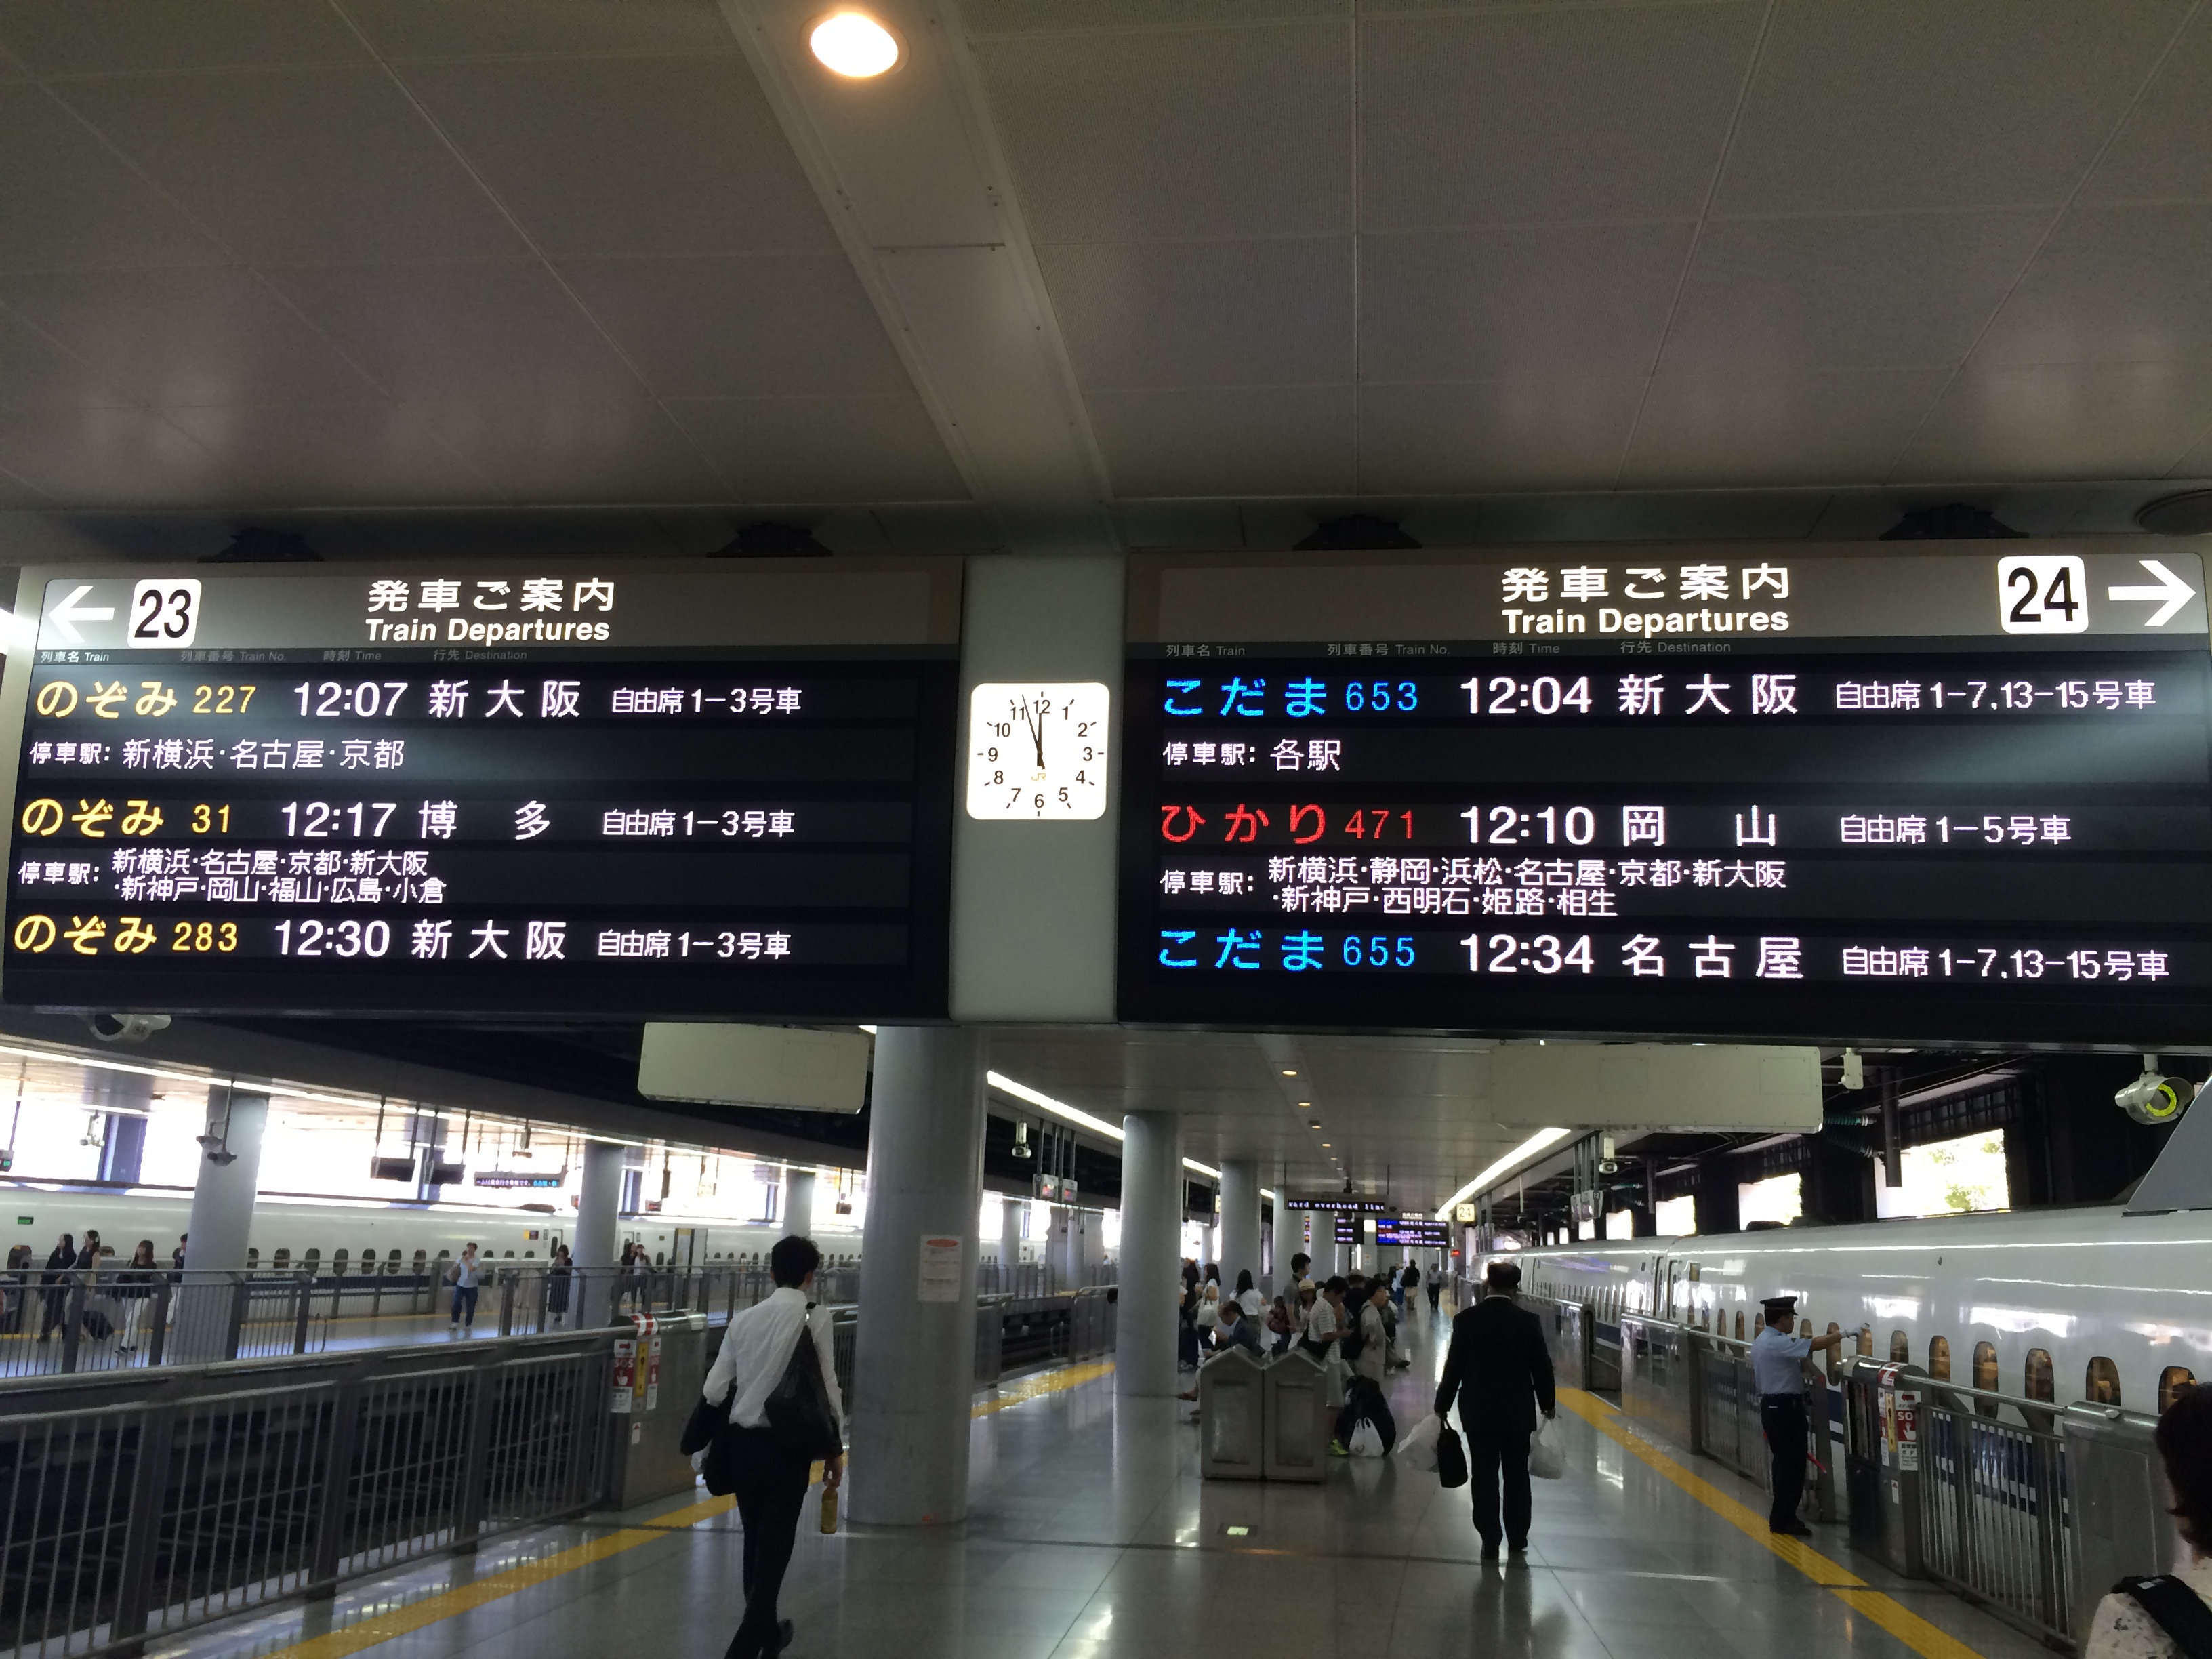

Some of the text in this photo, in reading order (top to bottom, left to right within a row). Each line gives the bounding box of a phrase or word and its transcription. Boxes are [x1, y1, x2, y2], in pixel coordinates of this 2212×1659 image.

[1502, 563, 1789, 602] 発車ご案内
[367, 577, 615, 613] 発車ご案内
[2007, 567, 2078, 622] 24
[134, 589, 192, 638] 23
[1502, 609, 1789, 638] Train Departures
[365, 618, 610, 646] Train Departures
[1166, 644, 1245, 657] 列車名 Train
[1328, 642, 1450, 656] 列車番号 Train No.
[1493, 642, 1559, 654] 時刻 Time
[1620, 641, 1731, 653] 行先 Destination
[41, 651, 109, 663] 列車名 Train
[181, 651, 286, 661] 列車番号 Train No.
[323, 650, 381, 661] 時刻 Time
[433, 649, 527, 660] 行先 Destination
[36, 680, 178, 718] のぞみ
[193, 685, 256, 714] 227
[293, 681, 408, 716] 12:07
[429, 679, 581, 718] 新大阪
[1164, 676, 1327, 717] こだま
[1345, 682, 1418, 711] 653
[1460, 676, 1592, 715] 12:04
[1618, 673, 1798, 715] 新大阪
[1010, 706, 1025, 720] 11
[1033, 700, 1050, 714] 12
[1062, 706, 1068, 720] 1
[994, 723, 1010, 737] 10
[1078, 723, 1088, 737] 2
[988, 747, 998, 762] 9
[1083, 747, 1092, 761] 3
[1270, 739, 1340, 771] 各駅
[994, 770, 1004, 784] 8
[1031, 773, 1047, 781] JR
[1076, 770, 1086, 784] 4
[1011, 788, 1021, 802] 7
[1034, 794, 1044, 808] 6
[1059, 787, 1068, 802] 5
[22, 798, 163, 837] のぞみ
[192, 804, 230, 833] 31
[281, 802, 397, 838] 12:17
[419, 800, 550, 840] 博多
[1161, 804, 1326, 844] ひかり
[1345, 810, 1413, 839] 471
[1460, 806, 1594, 845] 12:10
[1622, 804, 1777, 847] 岡山
[14, 915, 157, 955] のぞみ
[173, 922, 238, 951] 283
[274, 920, 390, 956] 12:30
[412, 919, 567, 959] 新大阪
[1159, 928, 1324, 970] こだま
[1343, 935, 1414, 966] 655
[1460, 933, 1594, 973] 12:34
[1622, 934, 1803, 979] 名古屋
[1459, 1207, 1471, 1218] 24
[615, 1359, 634, 1368] SOS
[1898, 1411, 1914, 1421] SO
